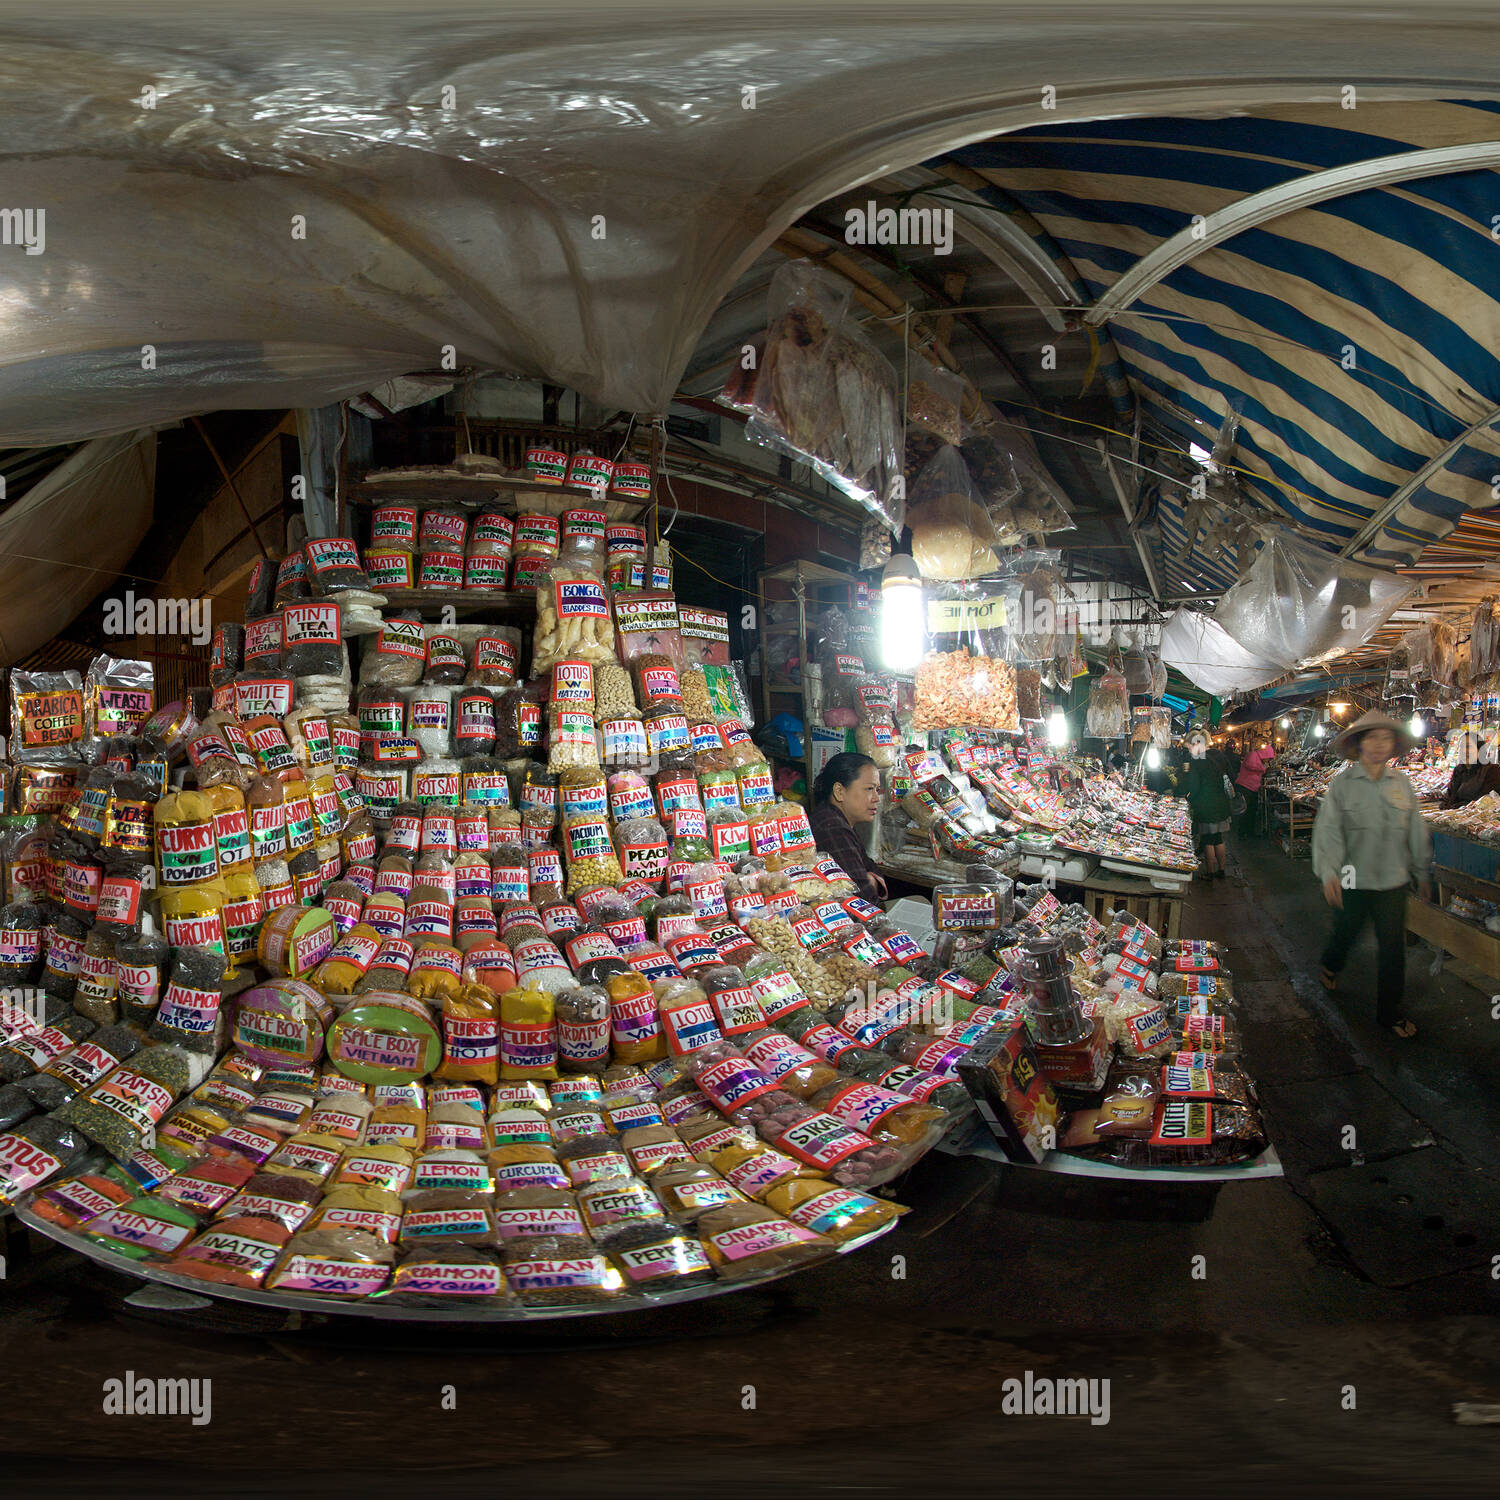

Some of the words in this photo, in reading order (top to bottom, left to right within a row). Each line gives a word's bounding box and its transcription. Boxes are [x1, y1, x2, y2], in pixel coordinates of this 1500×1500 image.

[526, 453, 567, 466] CURRY
[575, 459, 612, 474] BLACK
[467, 559, 504, 570] CUMIN
[286, 607, 332, 624] MINT
[646, 612, 676, 621] TRANG
[298, 621, 329, 631] TEA
[558, 667, 588, 681] LOTUS
[237, 685, 286, 700] WHITE
[25, 696, 79, 718] ARABICA
[245, 700, 277, 711] TEA
[415, 704, 447, 715] PEPPER
[34, 715, 77, 731] COFFEE
[565, 714, 593, 725] LOTUS
[606, 721, 637, 734] PLUM
[42, 728, 73, 742] BEAN
[564, 788, 605, 802] LEMON
[611, 792, 649, 808] STRAW
[160, 823, 213, 852] CURRY
[629, 847, 669, 862] PEACH
[166, 862, 217, 881] POWDER
[455, 887, 491, 897] CURRY
[942, 898, 993, 911] WEASEL
[240, 1012, 273, 1035] SPICE
[276, 1020, 306, 1040] BOX
[445, 1019, 496, 1037] CURRY
[342, 1028, 384, 1050] SPICE
[388, 1035, 420, 1054] BOX
[450, 1047, 488, 1058] HOT
[509, 1055, 553, 1065] POWDER
[557, 1115, 595, 1128] PEPPER
[577, 1155, 625, 1169] PEPPER
[348, 1161, 406, 1178] CURRY
[420, 1164, 480, 1177] LEMON
[499, 1166, 559, 1178] CURCUMA
[234, 1196, 306, 1219] ANATTO
[591, 1193, 652, 1211] PEPPER
[109, 1210, 174, 1236] MINT
[327, 1211, 398, 1227] CURRY
[498, 1210, 577, 1223] CORIAN
[504, 1261, 596, 1277] CORIAN
